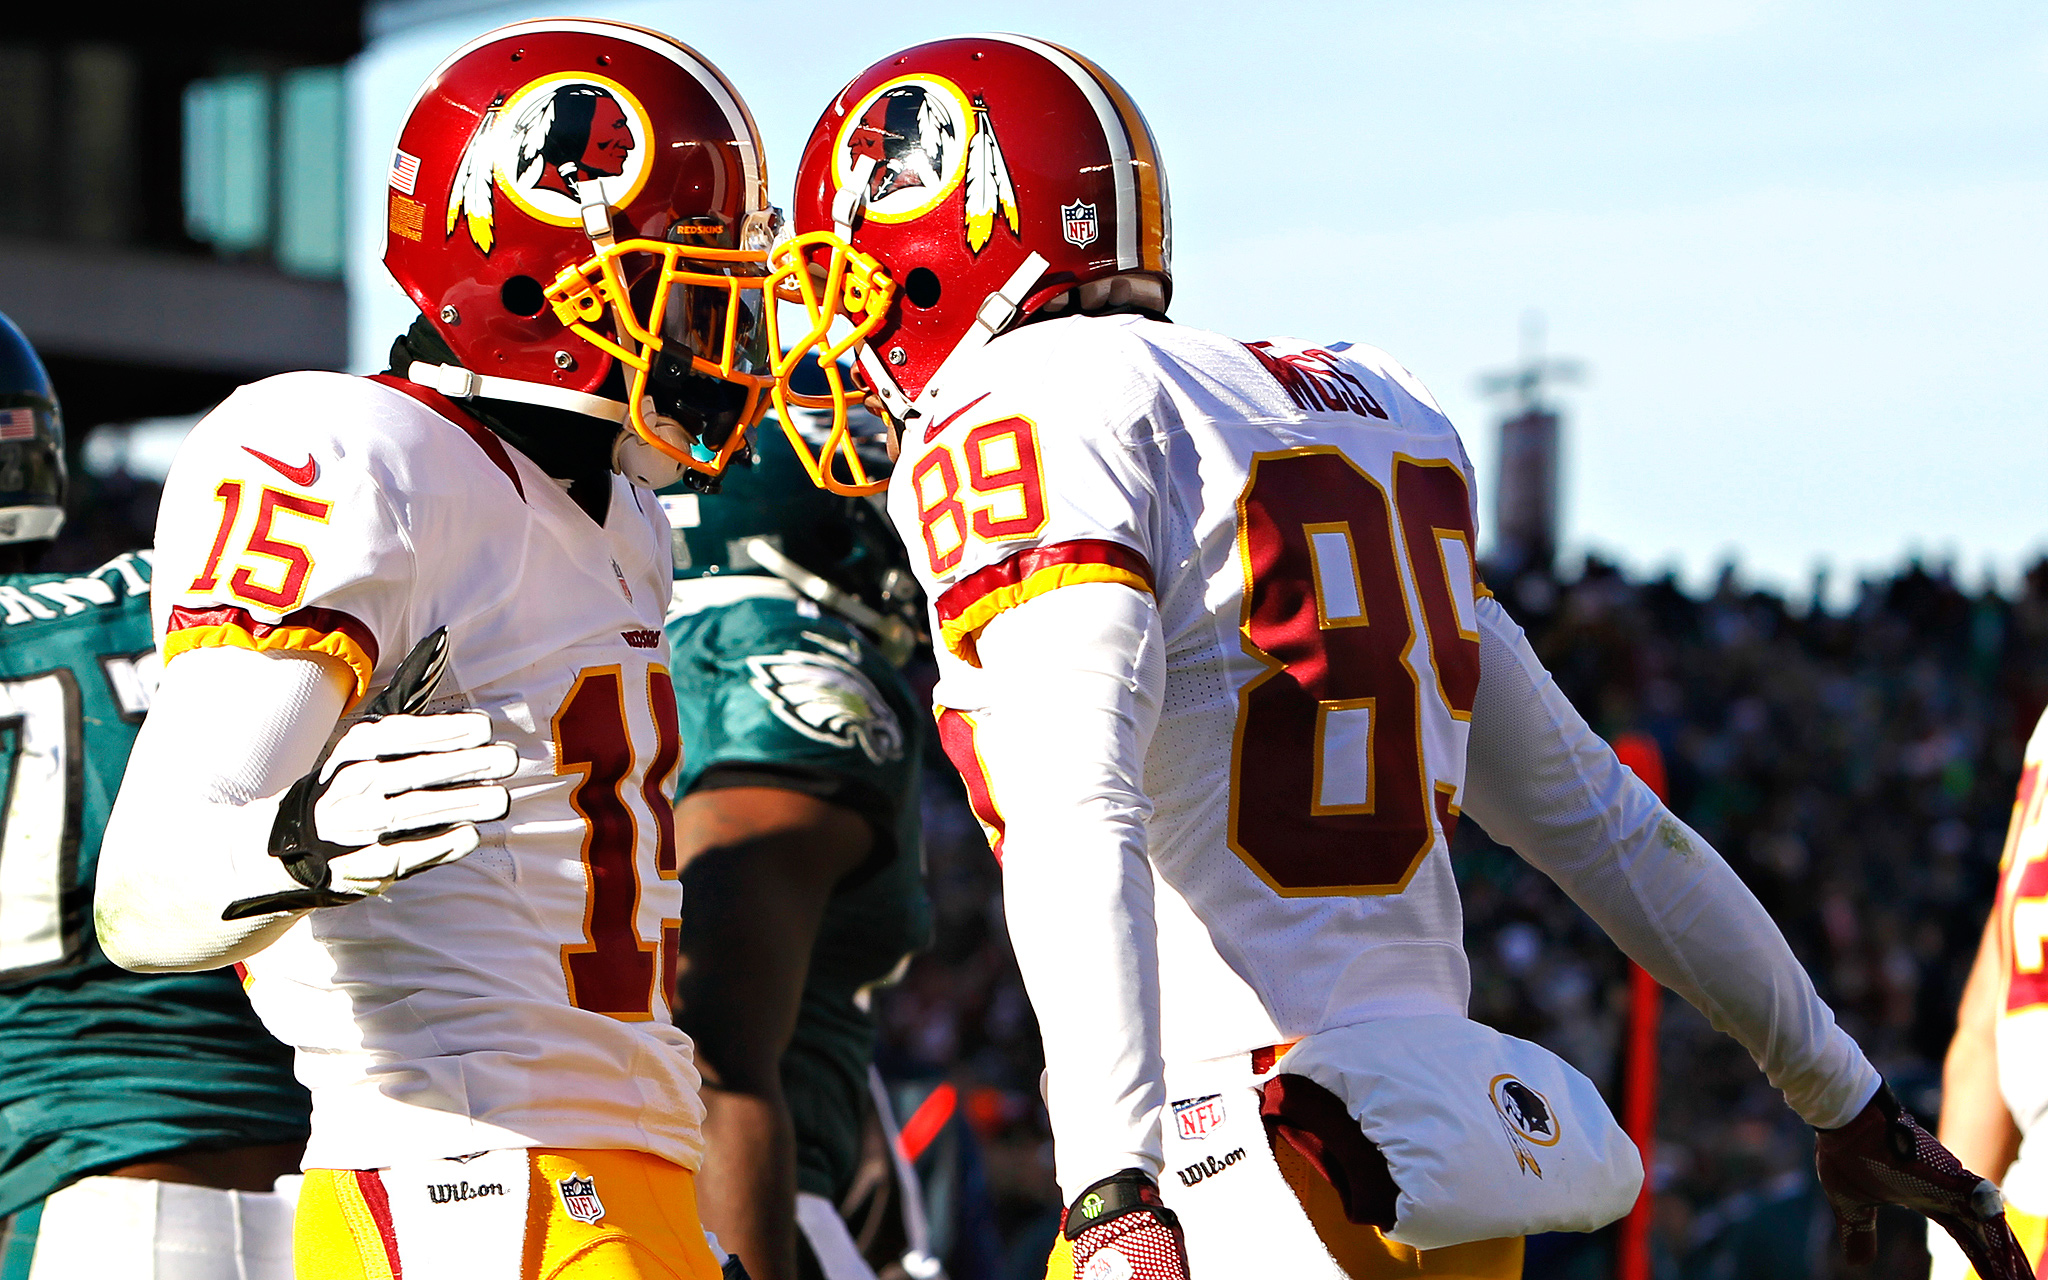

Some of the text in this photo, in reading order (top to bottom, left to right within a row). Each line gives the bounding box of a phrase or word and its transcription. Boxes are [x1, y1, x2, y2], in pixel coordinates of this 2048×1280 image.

[676, 225, 724, 235] REDSKINS
[1069, 221, 1093, 240] NFL
[911, 413, 1051, 580] 89
[185, 477, 336, 615] 15
[1226, 444, 1481, 898] 89
[1181, 1104, 1221, 1135] NFL
[1176, 1147, 1247, 1187] Wilson
[427, 1181, 505, 1204] Wilson
[569, 1197, 598, 1216] NFL
